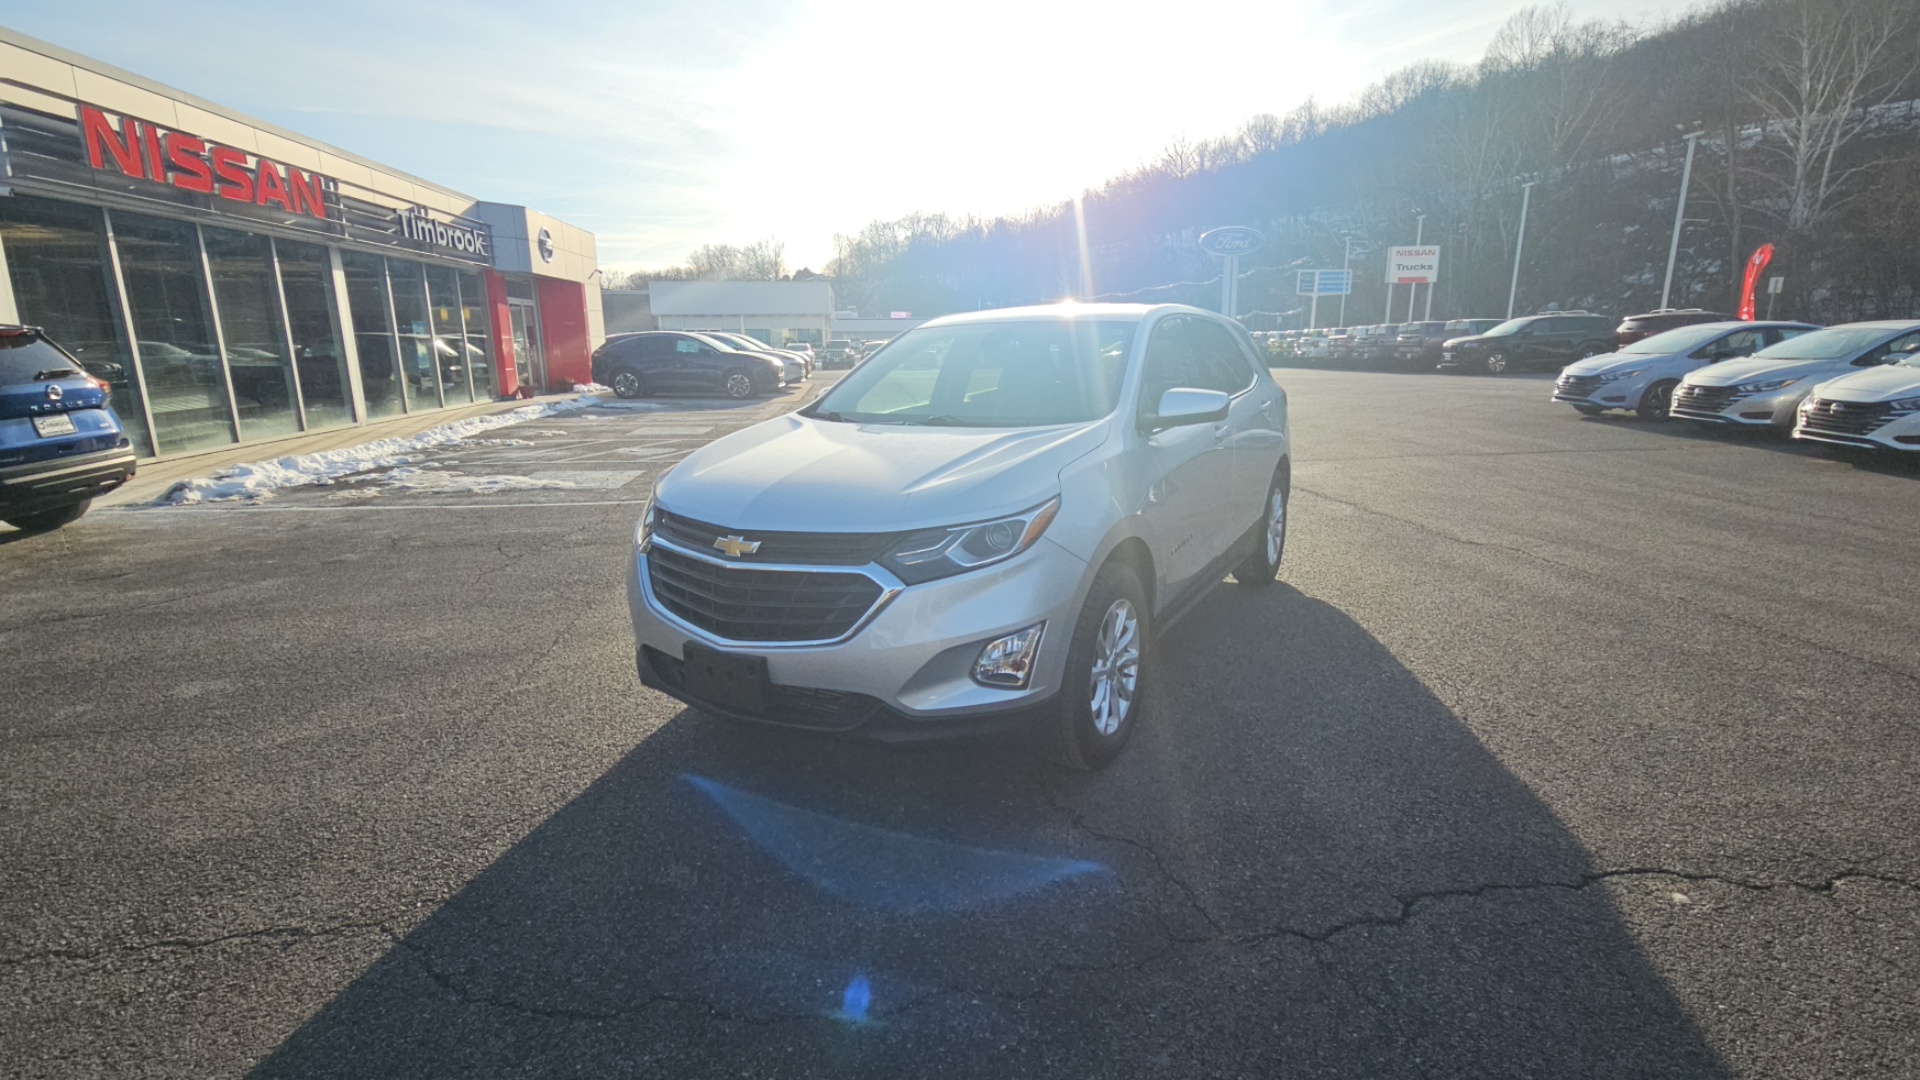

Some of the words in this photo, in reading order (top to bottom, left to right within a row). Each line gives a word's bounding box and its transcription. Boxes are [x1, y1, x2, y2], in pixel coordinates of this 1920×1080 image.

[80, 104, 326, 219] NISSAN
[396, 207, 489, 255] Timbrook
[1214, 232, 1253, 249] Ford
[1395, 249, 1436, 257] NISSAN
[1395, 263, 1434, 271] Trucks
